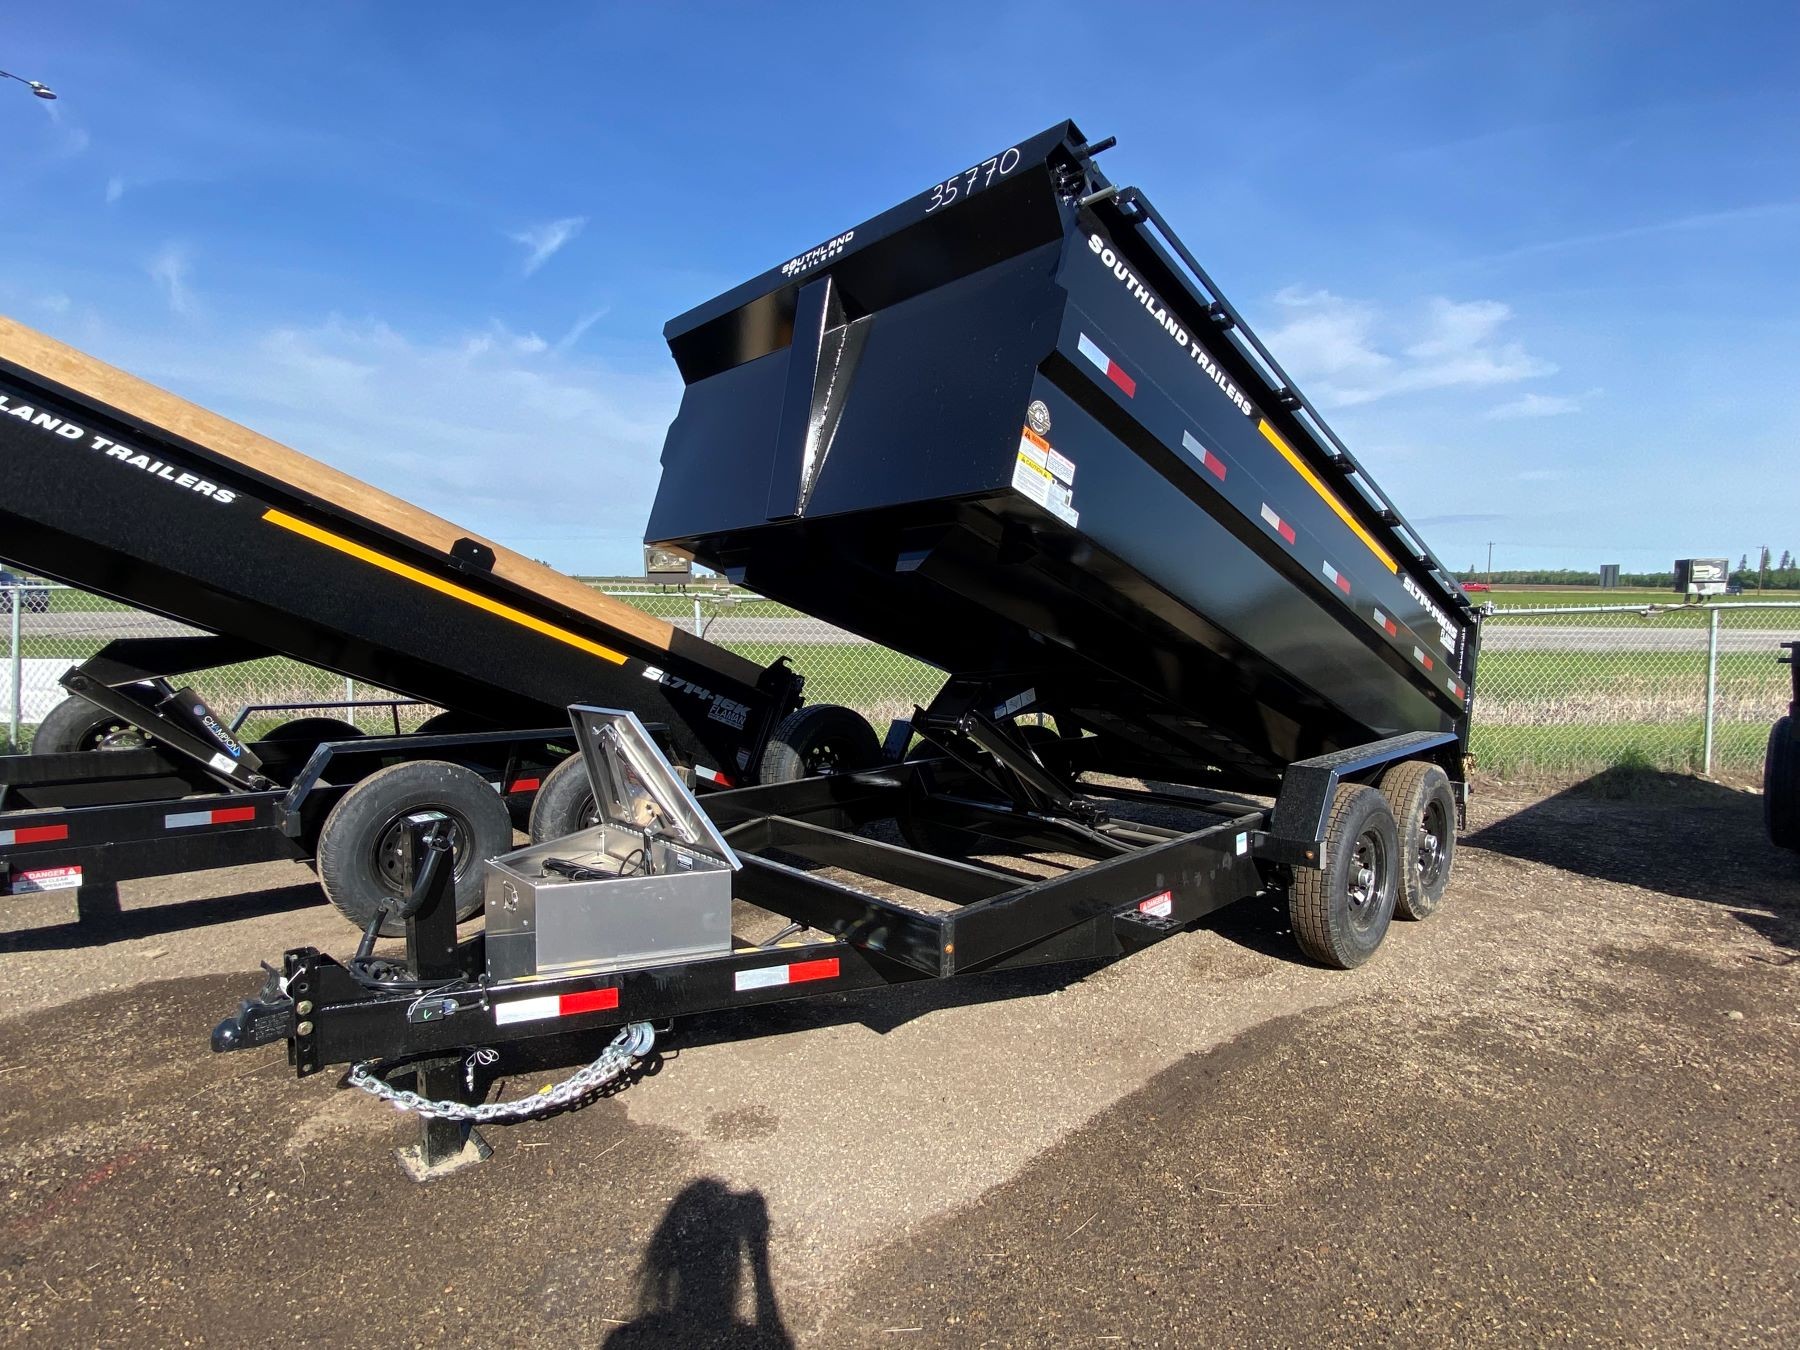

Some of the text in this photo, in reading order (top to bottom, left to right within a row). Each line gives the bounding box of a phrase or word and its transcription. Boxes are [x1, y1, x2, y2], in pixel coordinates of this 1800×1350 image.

[926, 148, 1020, 212] 35770
[781, 231, 854, 273] SOUTHLAND
[788, 246, 843, 277] TRAILERS
[1088, 234, 1252, 416] SOUTHLAND TRAILERS
[91, 436, 236, 503] TRAILERS
[204, 715, 240, 752] CHAMPION
[710, 704, 746, 725] FLAMAN
[28, 869, 65, 879] DANGER
